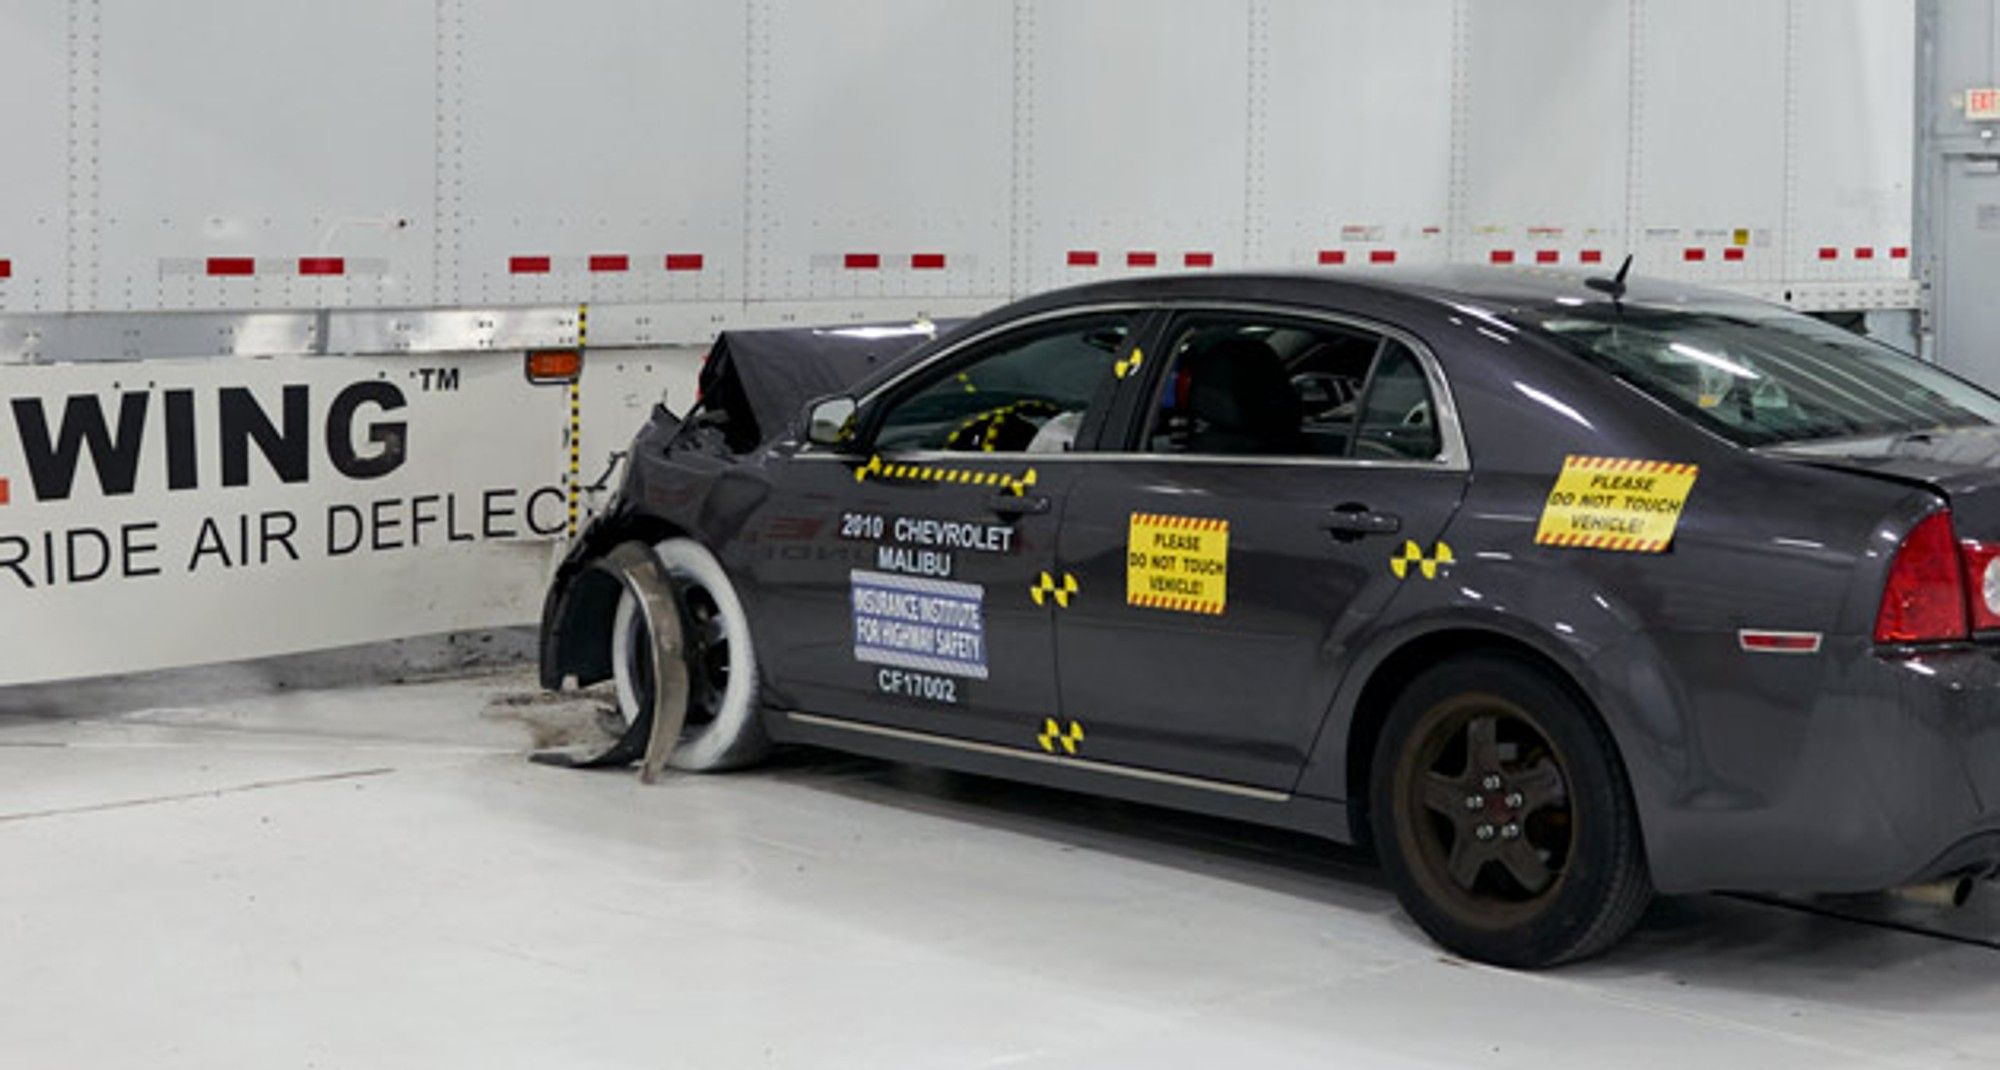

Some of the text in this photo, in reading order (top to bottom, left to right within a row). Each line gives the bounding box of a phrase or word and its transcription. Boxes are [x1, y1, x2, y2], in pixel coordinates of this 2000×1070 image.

[0, 380, 408, 502] WING
[1590, 474, 1657, 492] PLEASE
[1550, 492, 1682, 514] DO NOT TOUCH
[187, 509, 300, 572] AIR
[326, 487, 568, 557] DEFLEC
[841, 513, 884, 539] 2010
[894, 517, 1014, 552] CHEVROLET
[1153, 532, 1201, 552] PLEASE
[878, 545, 951, 577] MALIBU
[1130, 552, 1225, 576] DO NOT TOUCH
[853, 587, 981, 630] INSURANCE INSTITUTE
[856, 615, 981, 661] FOR HIGHWAY SAFETY
[878, 669, 957, 703] CF17002
